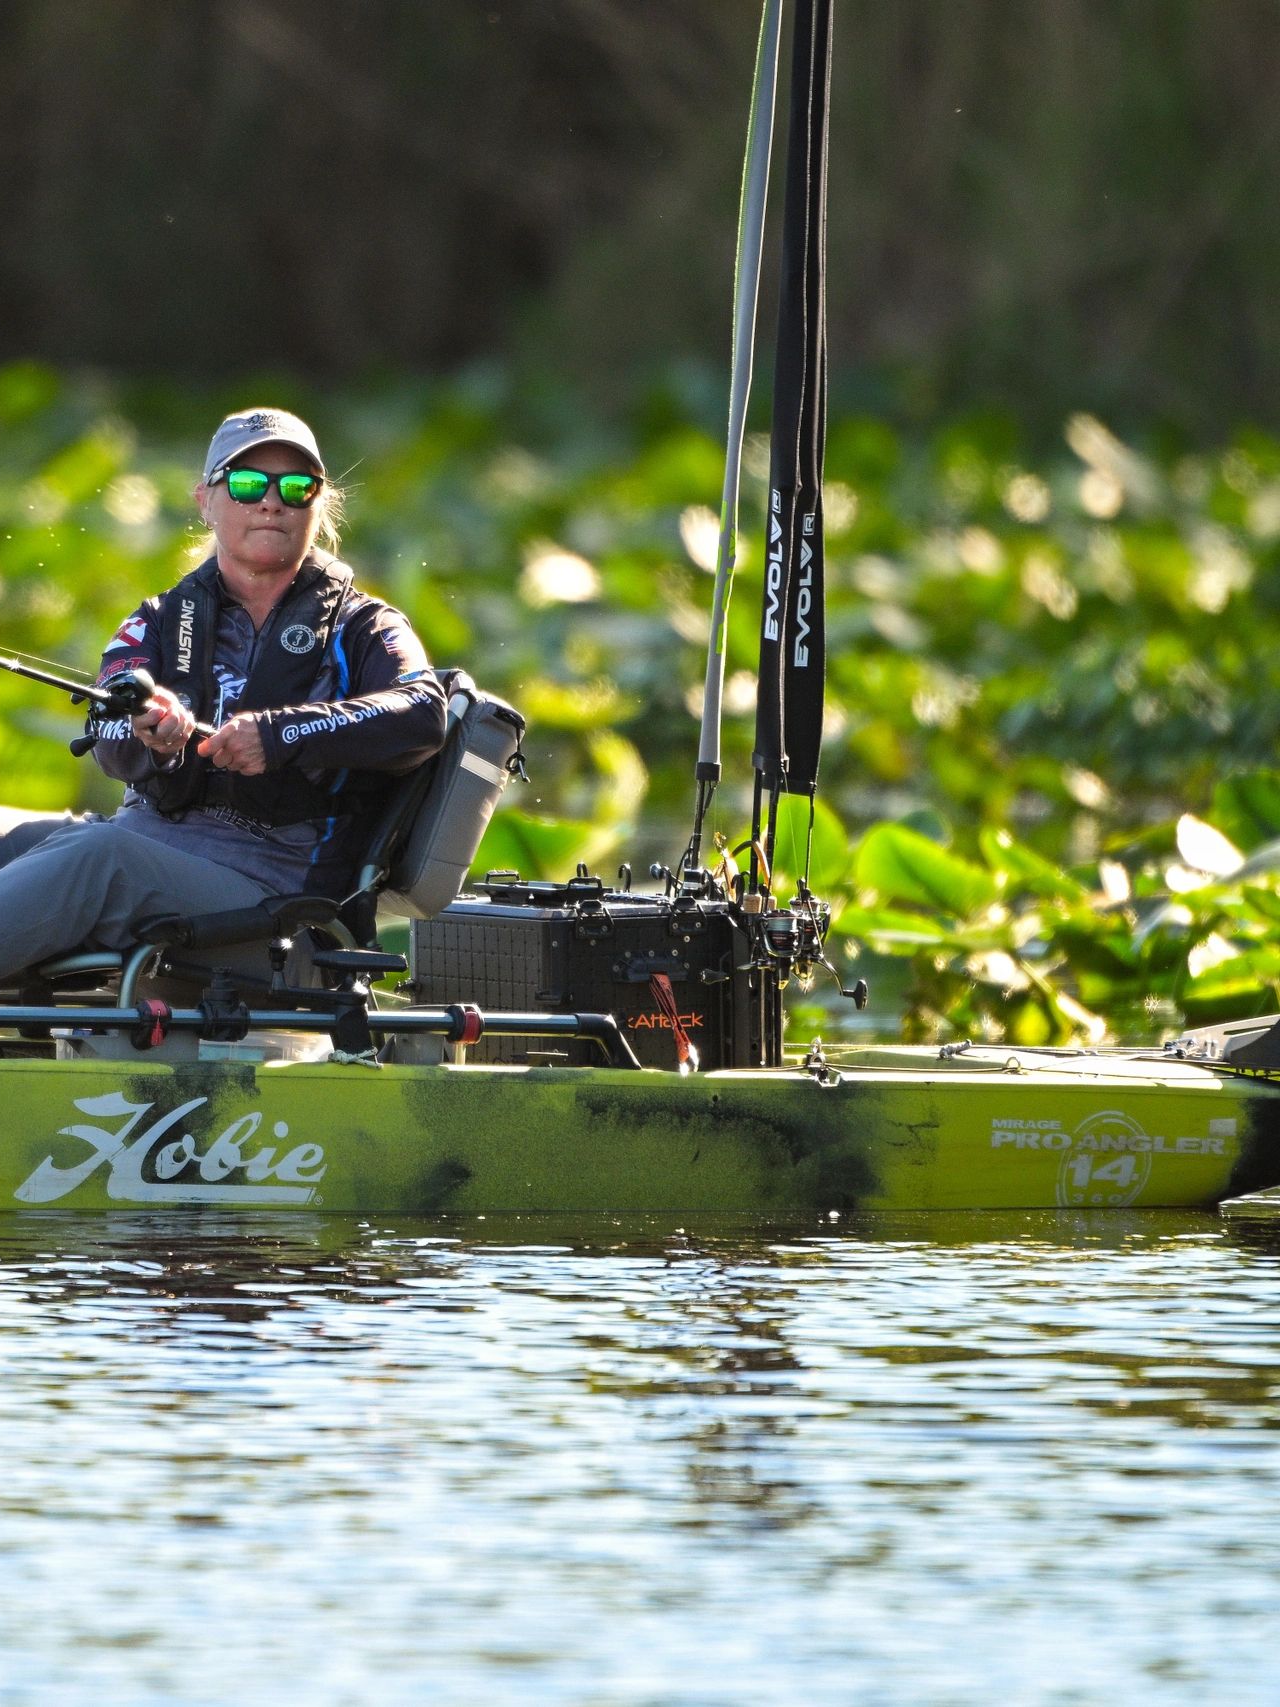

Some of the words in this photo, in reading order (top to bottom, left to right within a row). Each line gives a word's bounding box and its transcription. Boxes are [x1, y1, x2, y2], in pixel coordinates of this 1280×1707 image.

[177, 600, 195, 673] MUSTANG
[13, 1091, 328, 1205] Hobie
[991, 1119, 1062, 1130] MIRAGE
[1069, 1154, 1139, 1188] 14
